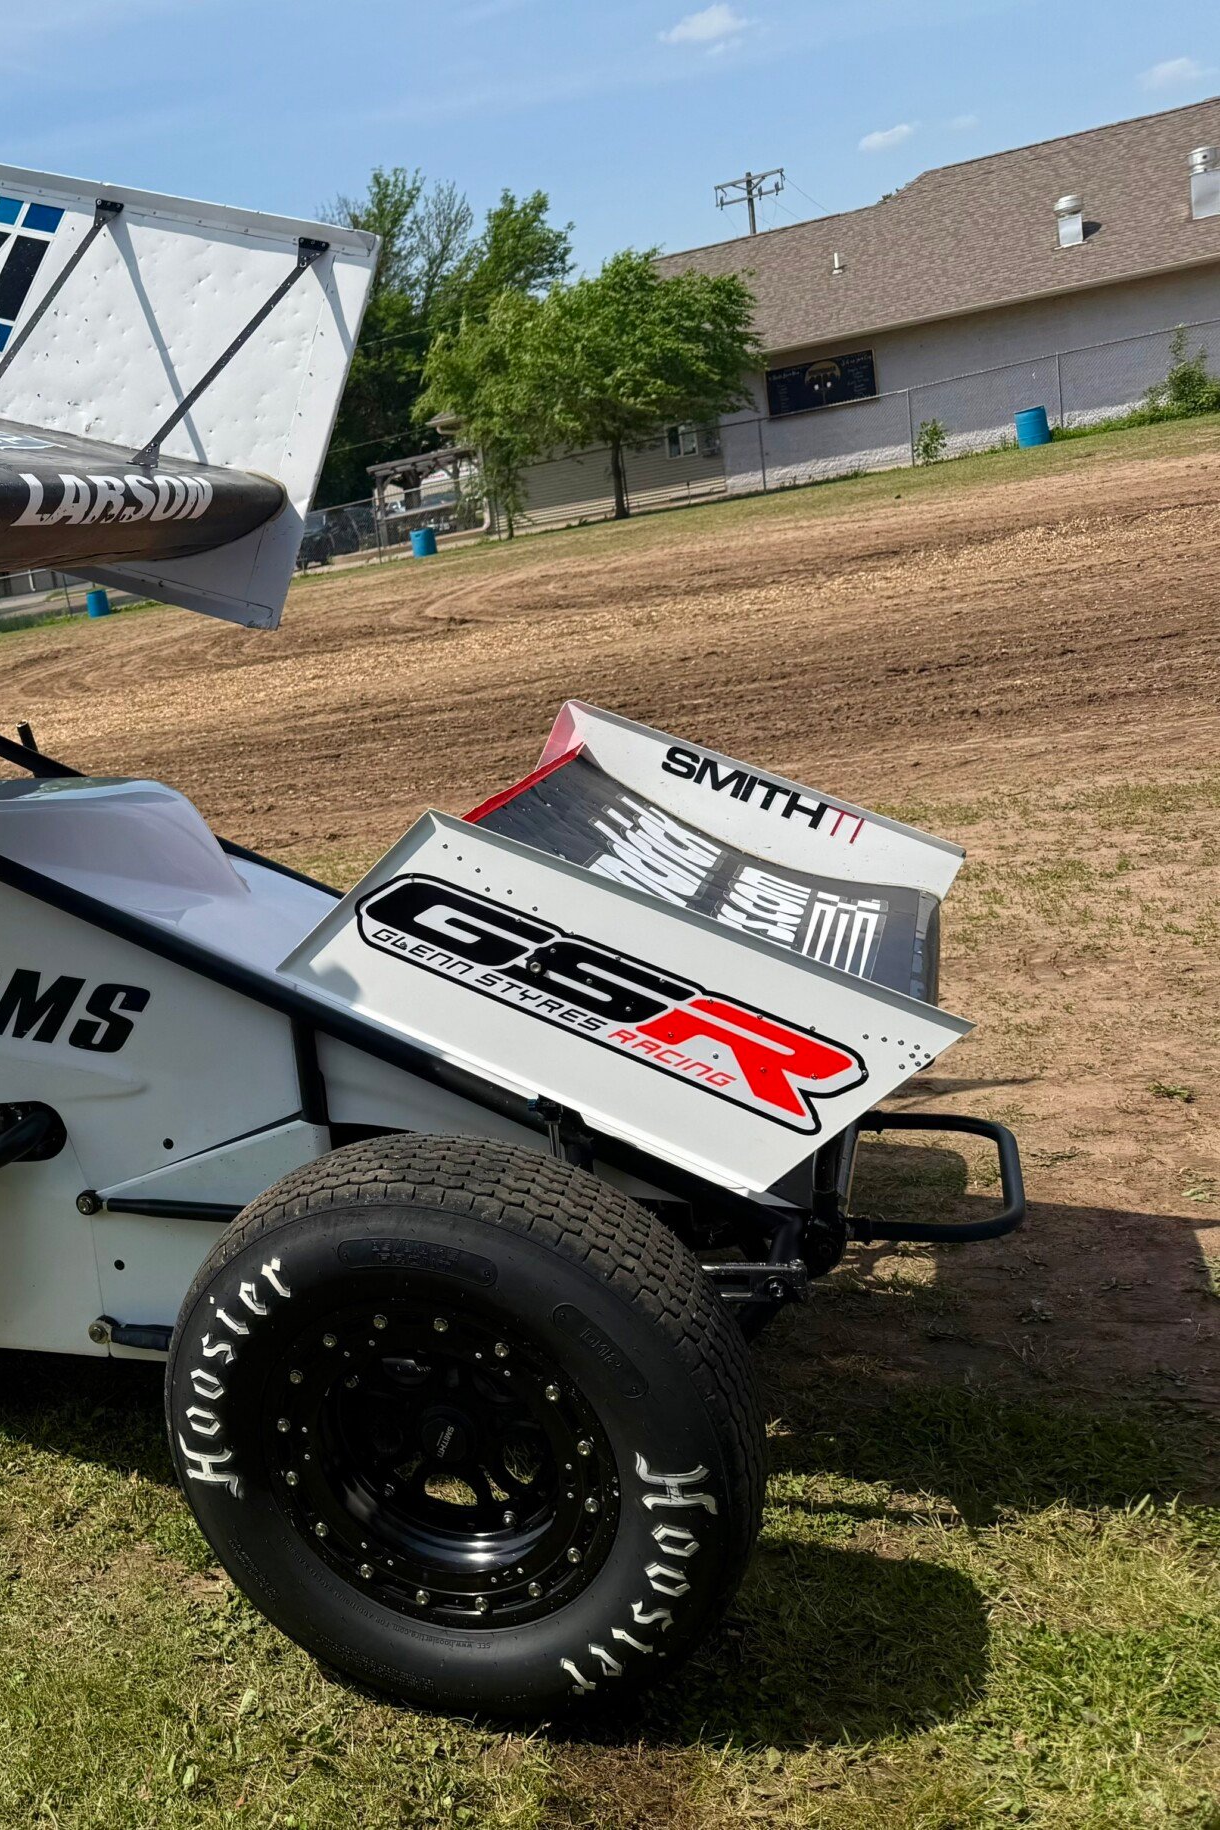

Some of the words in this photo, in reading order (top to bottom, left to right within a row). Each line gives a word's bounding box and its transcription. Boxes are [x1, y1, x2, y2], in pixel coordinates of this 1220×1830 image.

[11, 472, 215, 527] LARSON
[366, 881, 856, 1117] GSR
[372, 928, 475, 978] GLENN
[476, 971, 608, 1032] STYRES
[608, 1027, 738, 1090] RACING
[178, 1257, 293, 1499] Hoosier
[560, 1450, 718, 1695] Hoosier
